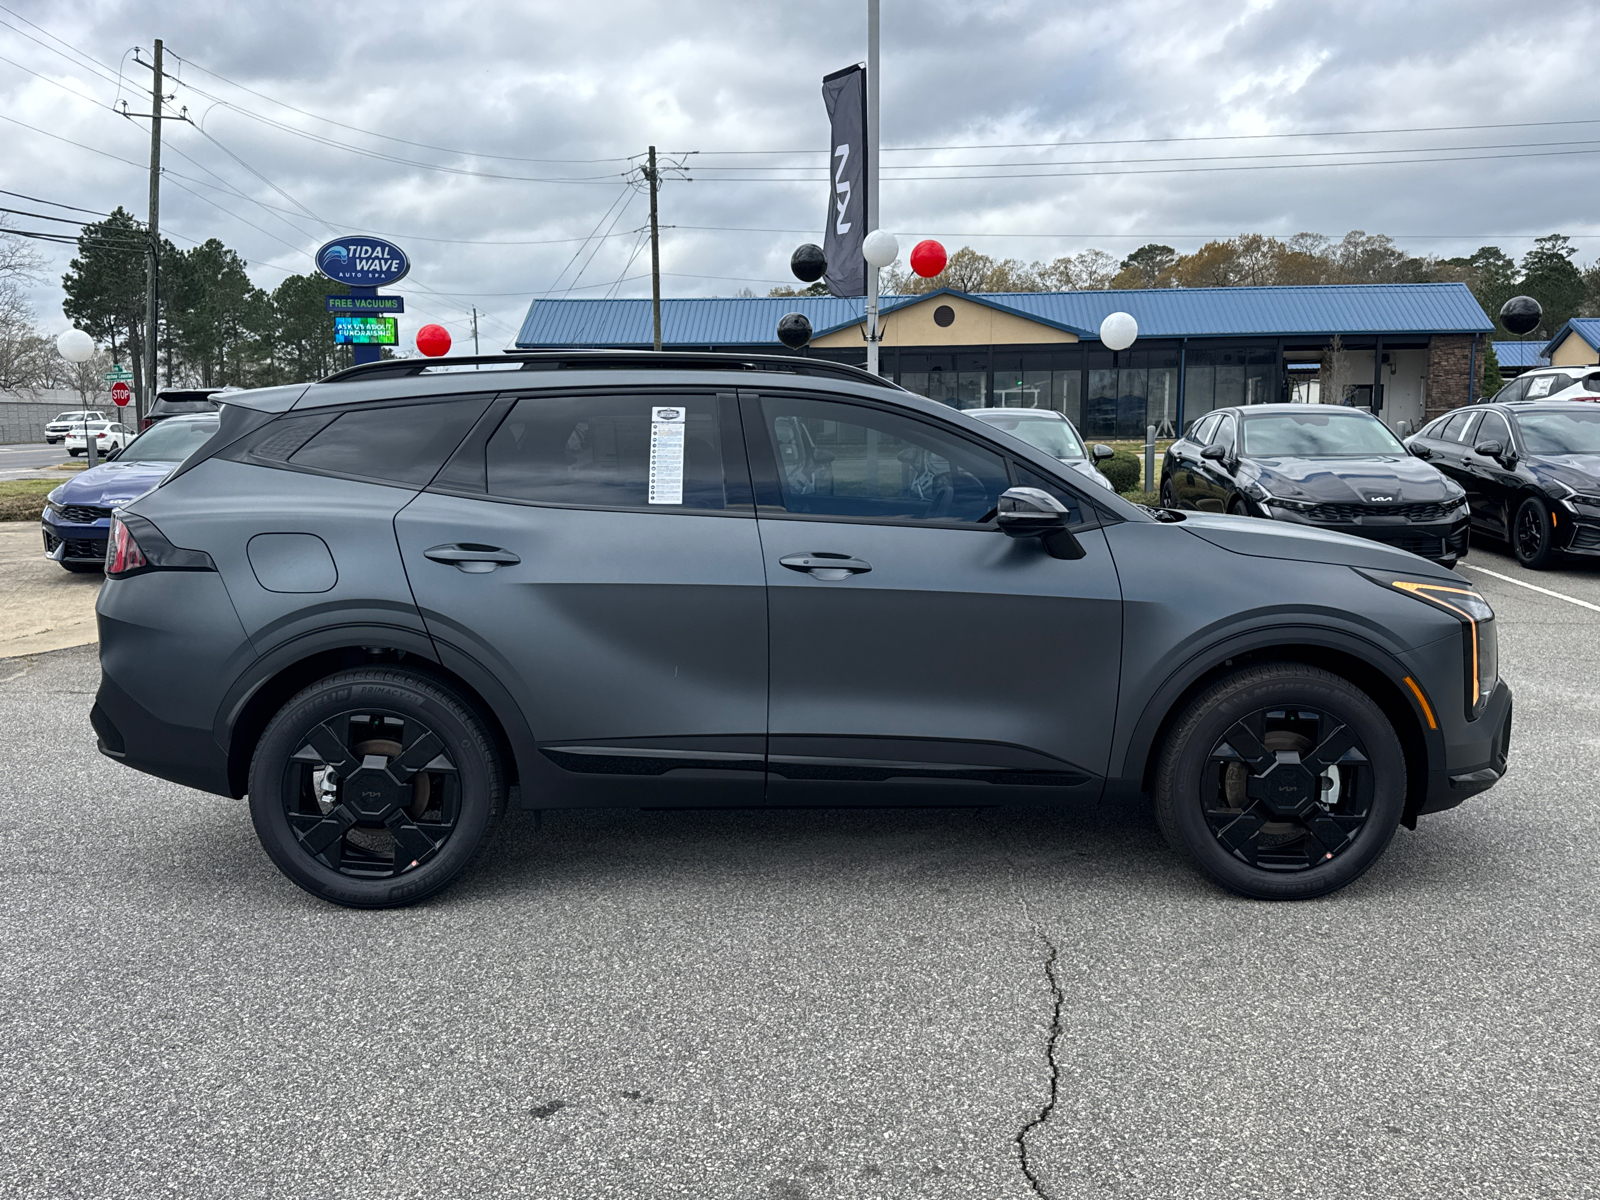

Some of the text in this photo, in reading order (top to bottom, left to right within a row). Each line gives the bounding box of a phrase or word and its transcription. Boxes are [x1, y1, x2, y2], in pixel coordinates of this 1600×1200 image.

[348, 245, 391, 259] TIDAL
[355, 259, 400, 272] WAVE
[329, 299, 398, 308] FREE VACUUMS
[112, 389, 129, 400] STOP
[282, 689, 349, 734] MICHELIN
[360, 686, 407, 699] PRIMACY
